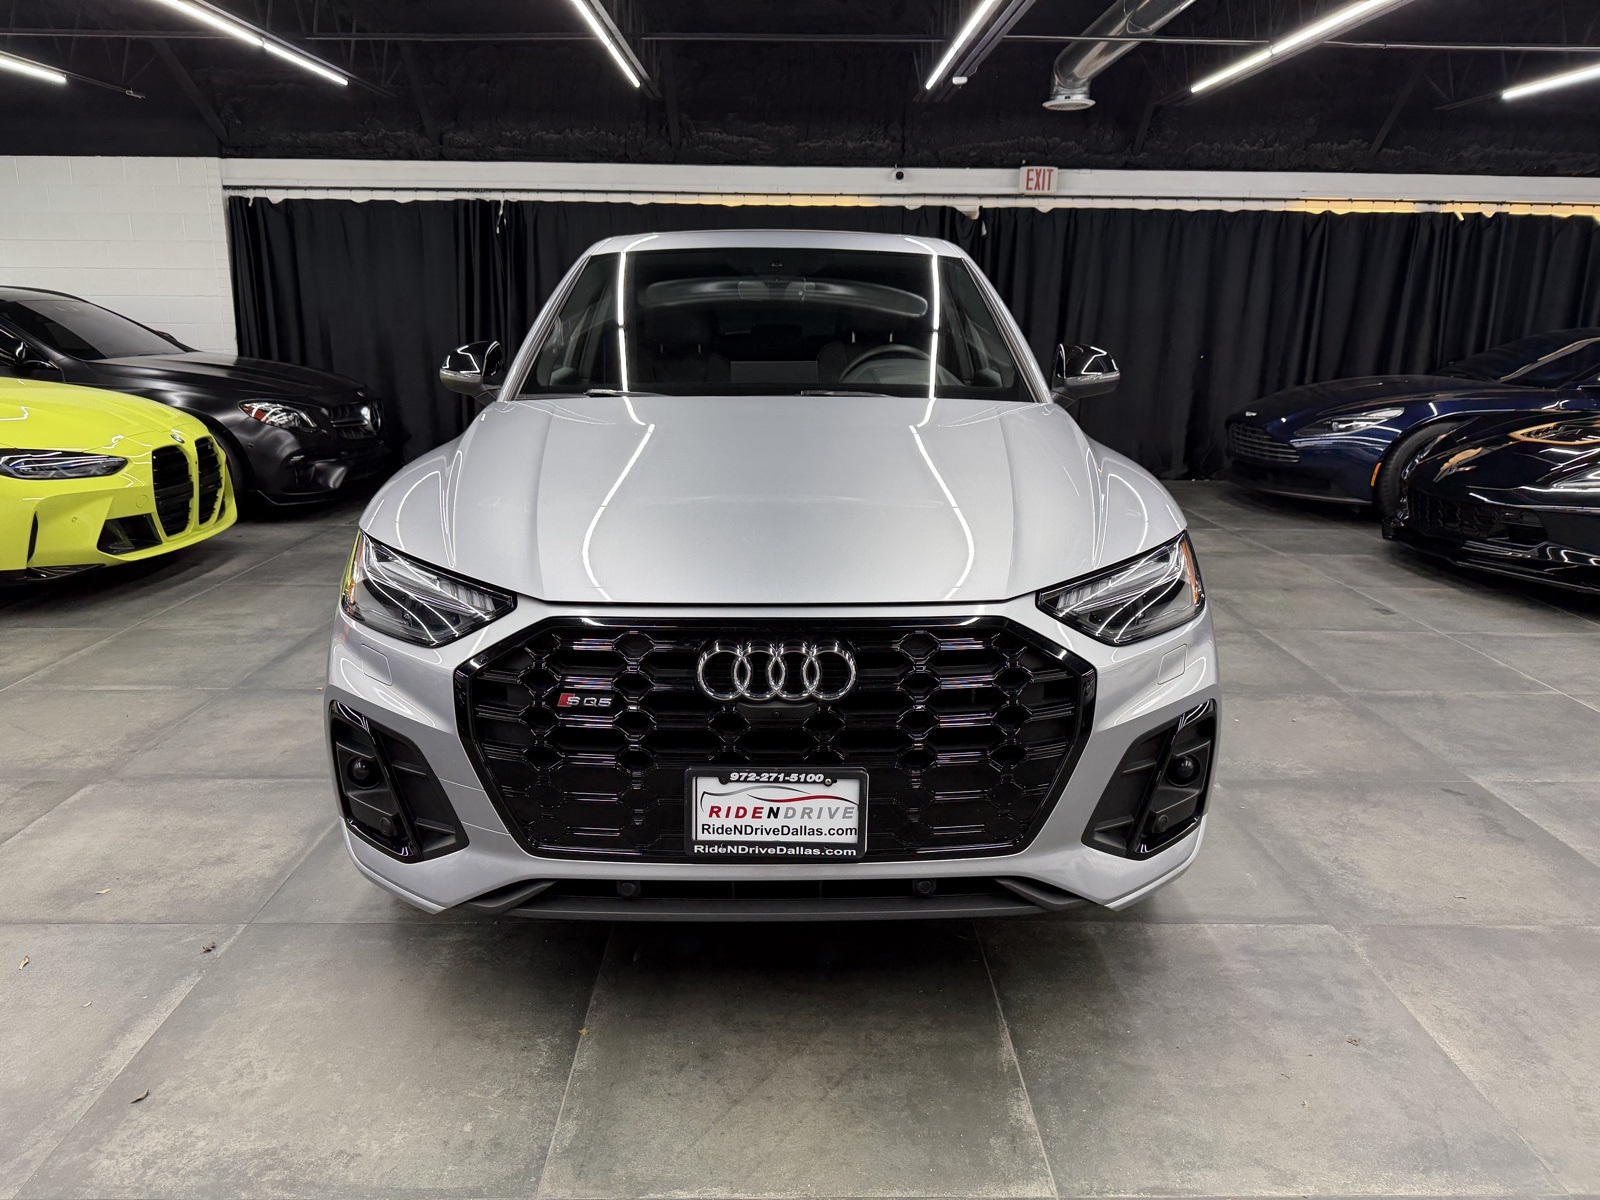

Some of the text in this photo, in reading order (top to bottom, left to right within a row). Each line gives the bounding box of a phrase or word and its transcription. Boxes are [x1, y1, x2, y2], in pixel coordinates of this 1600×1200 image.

[1026, 168, 1054, 191] EXIT
[566, 696, 612, 707] SQ5
[729, 772, 825, 783] 972-271-5100
[708, 805, 855, 820] RIDENDRIVE
[701, 823, 858, 837] RideNDriveDallas.com
[693, 844, 857, 856] RideNDriveDallas.com
